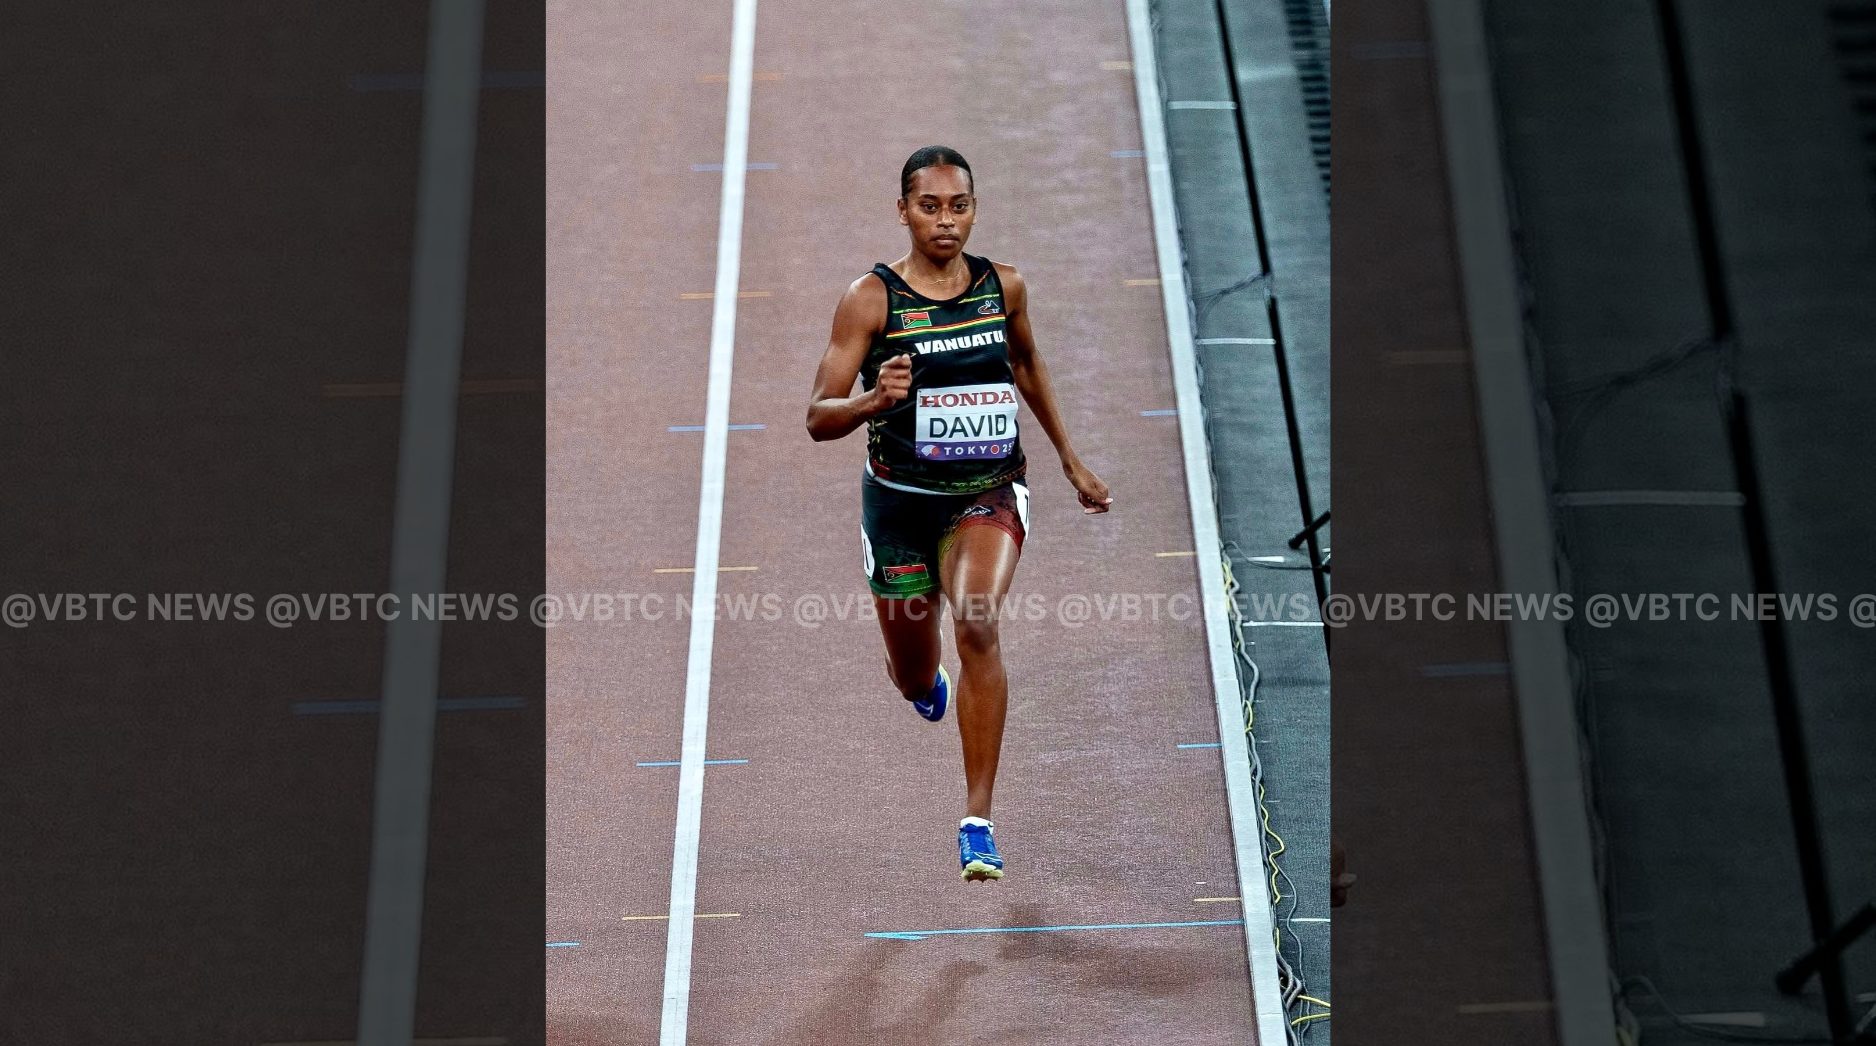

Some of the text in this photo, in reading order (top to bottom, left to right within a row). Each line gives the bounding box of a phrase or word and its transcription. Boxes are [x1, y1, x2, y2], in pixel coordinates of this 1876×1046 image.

[915, 330, 1003, 354] VANUATU
[920, 391, 1015, 407] HONDA
[929, 413, 1007, 438] DAVID
[944, 444, 999, 456] TOKYO
